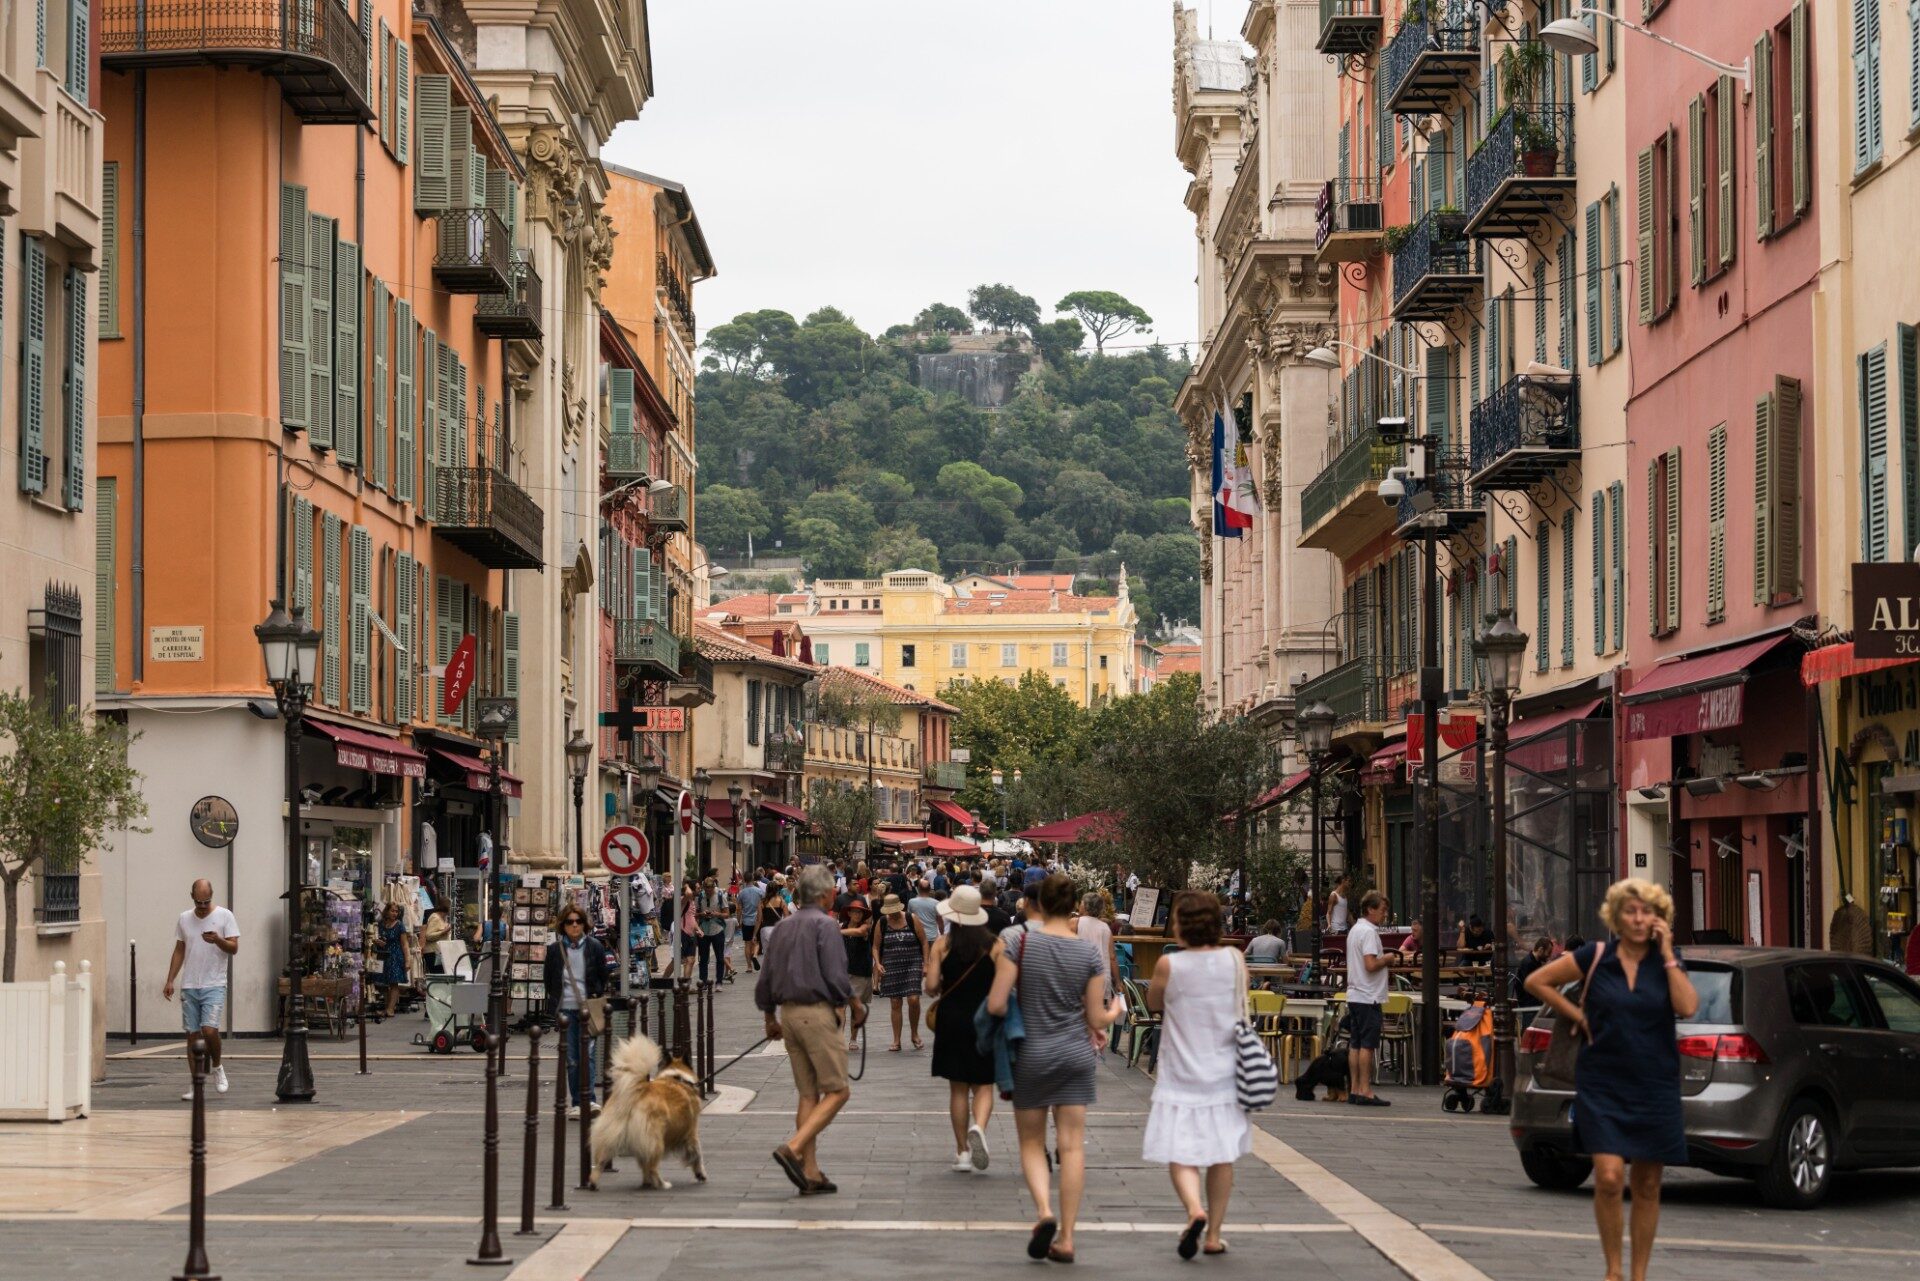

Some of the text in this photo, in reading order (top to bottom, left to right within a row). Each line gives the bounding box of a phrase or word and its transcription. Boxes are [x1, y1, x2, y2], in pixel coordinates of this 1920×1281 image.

[1868, 597, 1920, 631] AL
[451, 651, 470, 699] TABAC
[1637, 855, 1646, 866] 12
